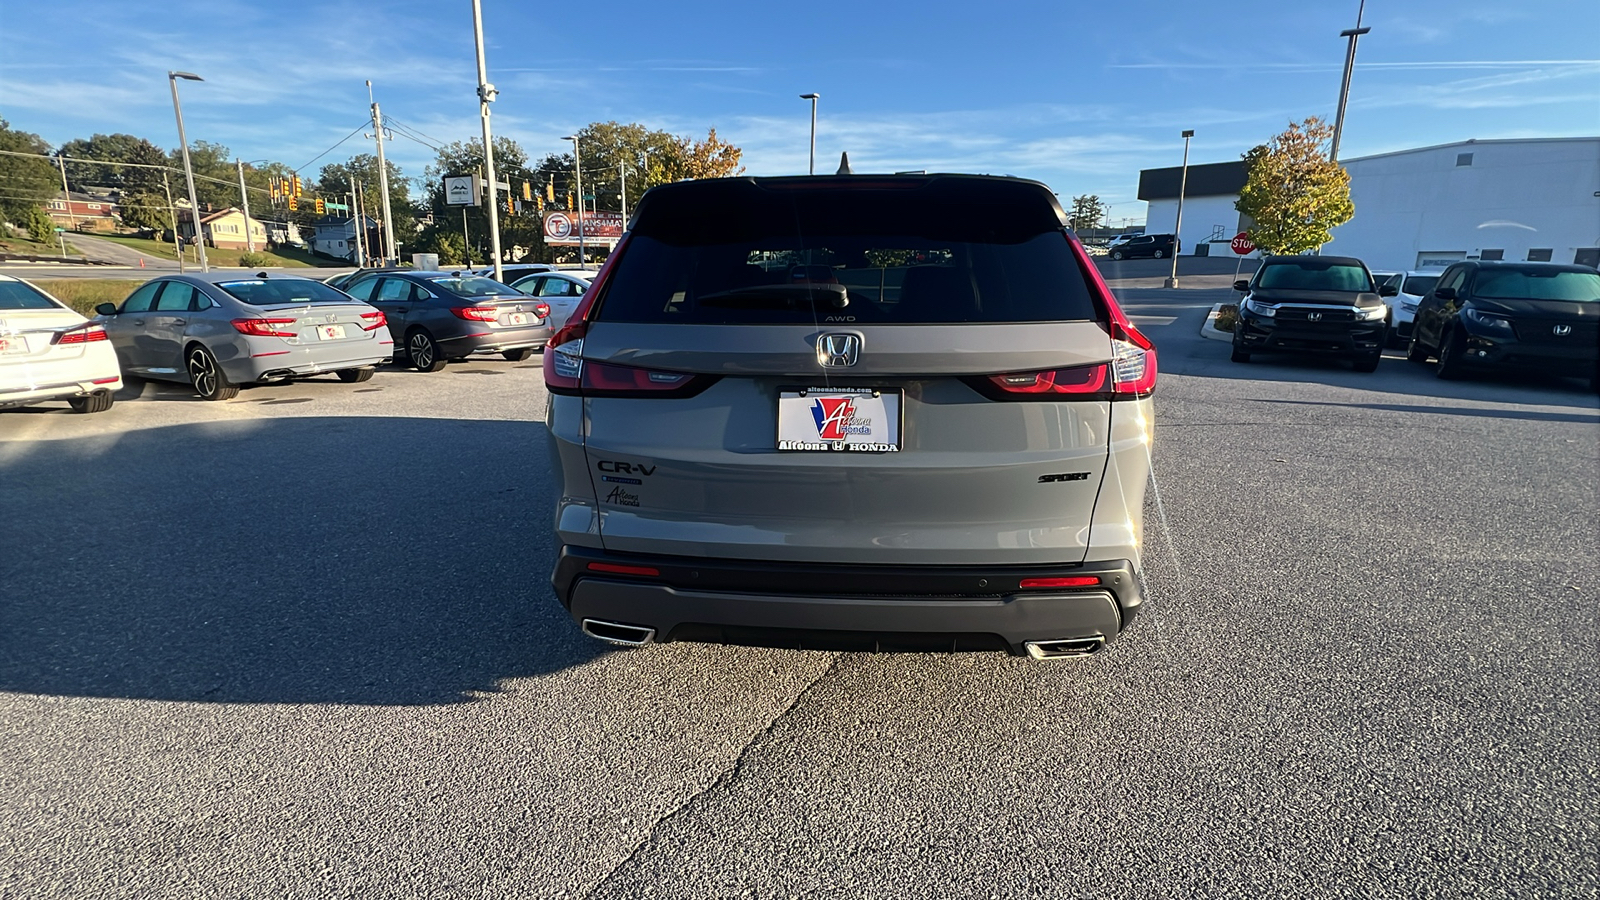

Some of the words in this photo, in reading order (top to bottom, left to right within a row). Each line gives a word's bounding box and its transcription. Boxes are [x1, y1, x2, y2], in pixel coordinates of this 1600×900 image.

[807, 386, 872, 394] altoonahonda.com
[841, 425, 871, 434] Honda
[779, 440, 829, 451] Altoona
[849, 441, 899, 452] HONDA
[597, 460, 657, 476] CR-V
[1037, 472, 1091, 483] SPORT
[620, 499, 640, 507] Honda
